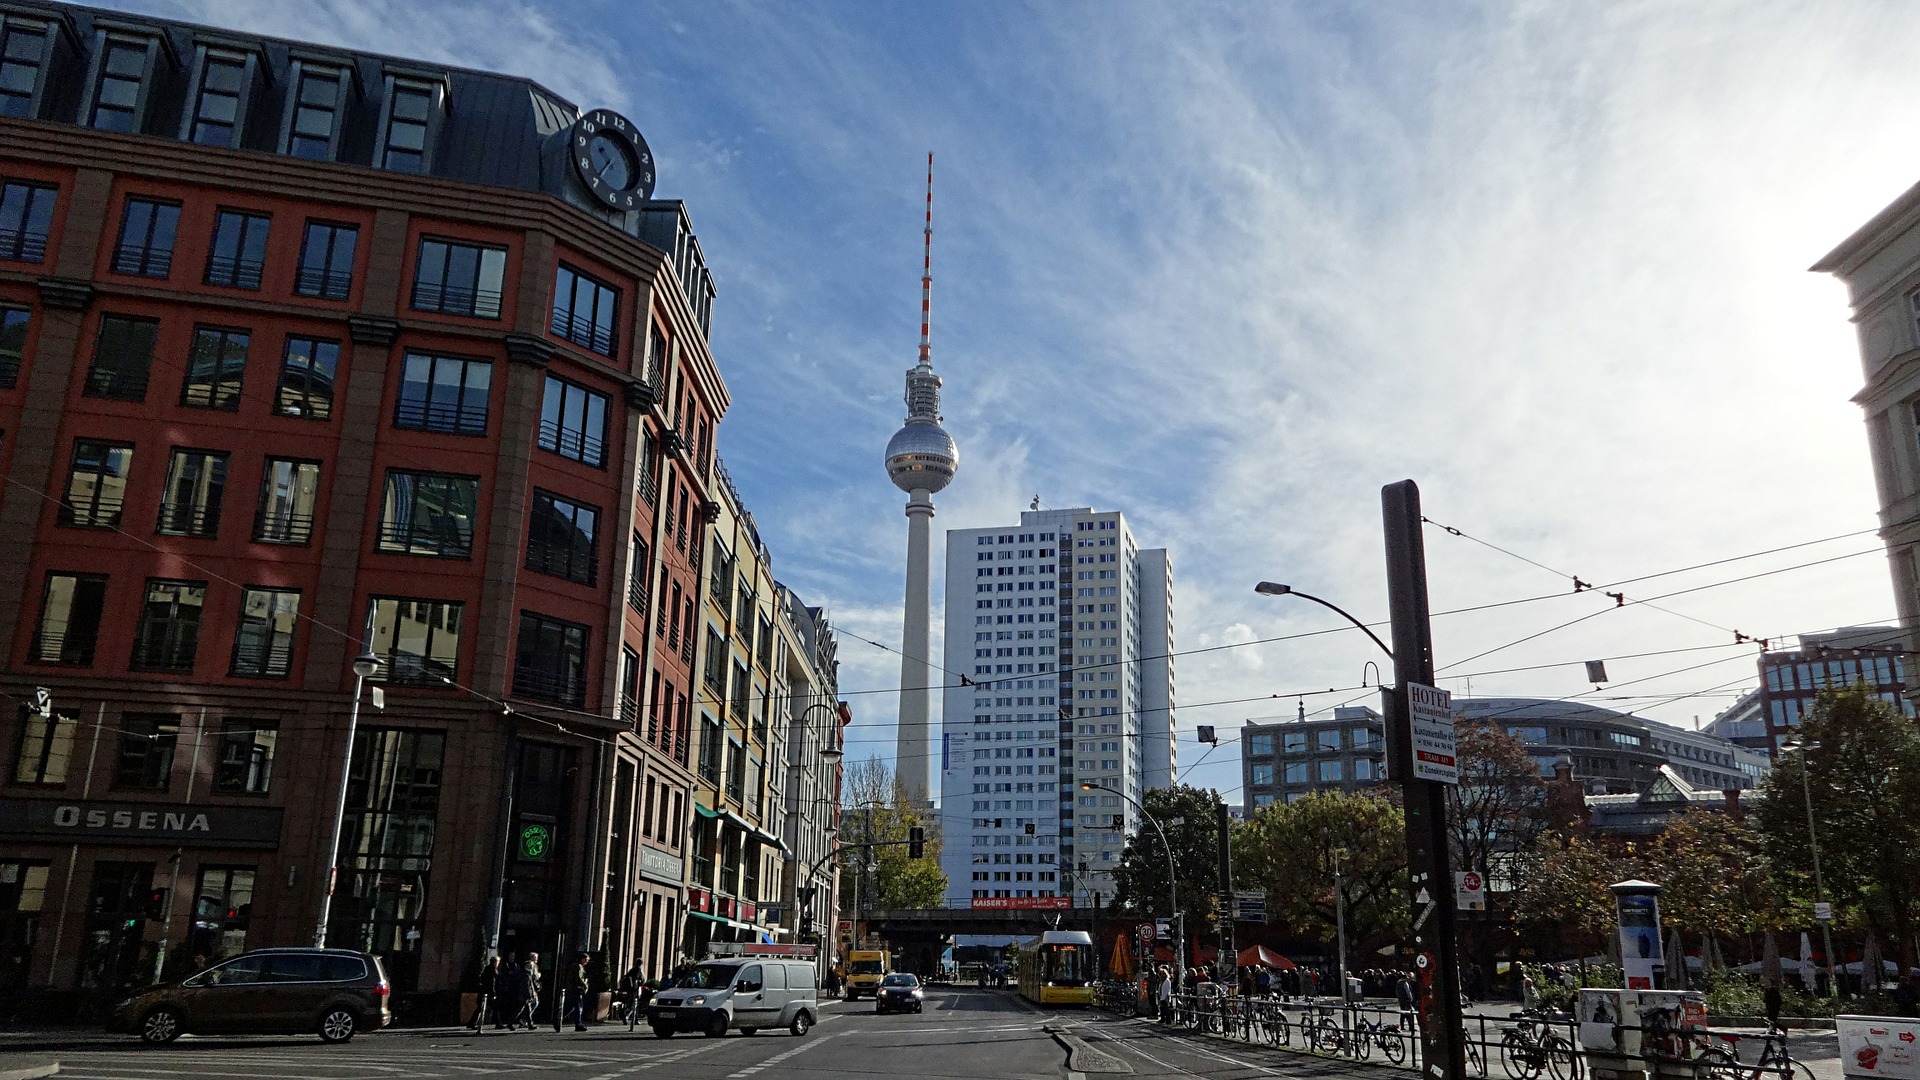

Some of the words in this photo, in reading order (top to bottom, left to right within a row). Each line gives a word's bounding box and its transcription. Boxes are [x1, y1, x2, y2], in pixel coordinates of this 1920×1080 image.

[596, 111, 606, 126] 11
[613, 116, 626, 131] 12
[582, 119, 595, 133] 10
[578, 135, 586, 147] 9
[633, 133, 639, 144] 1
[581, 157, 589, 169] 8
[641, 152, 649, 164] 2
[592, 177, 600, 188] 7
[644, 171, 651, 183] 3
[609, 192, 616, 203] 6
[636, 187, 644, 199] 4
[626, 195, 633, 206] 5
[1412, 686, 1451, 710] HOTEL
[1423, 752, 1440, 762] TRAM
[53, 805, 211, 832] OSSENA
[972, 898, 1008, 907] KAISER'S
[1142, 927, 1152, 937] 30
